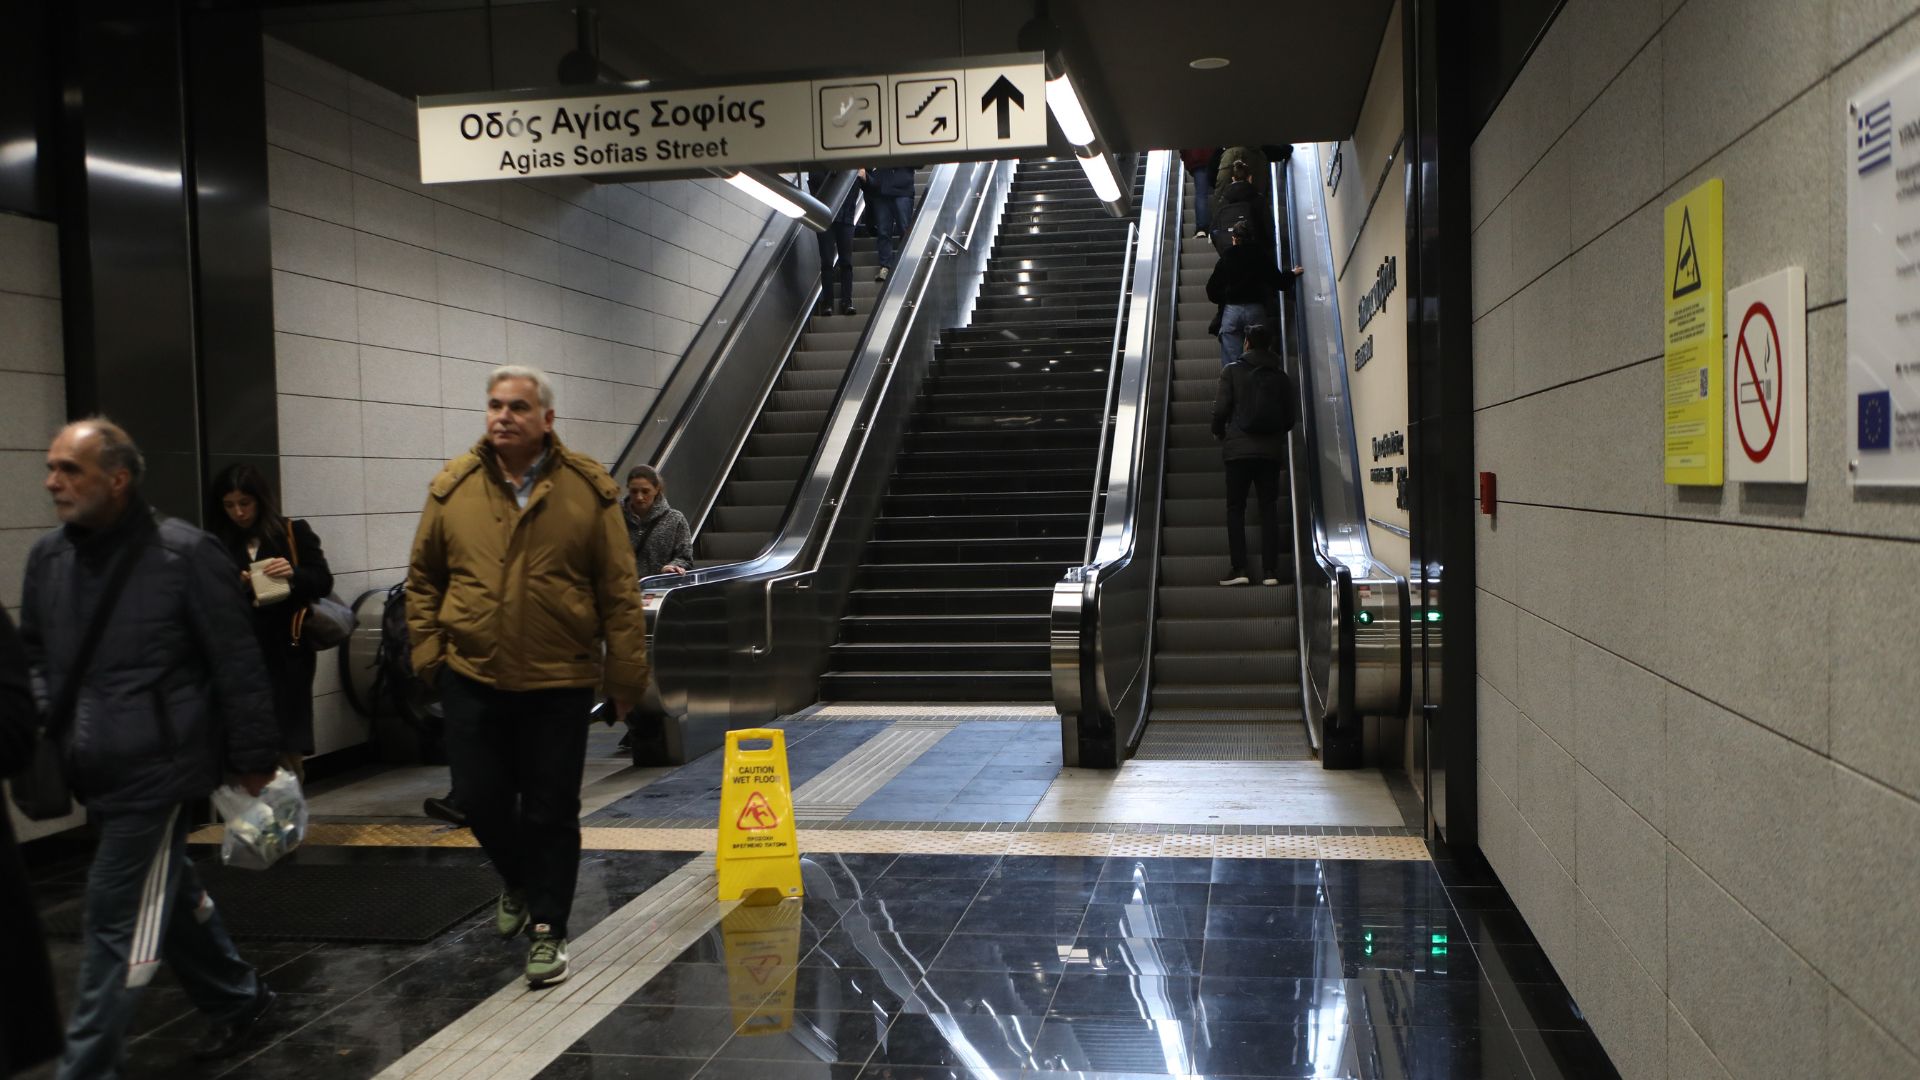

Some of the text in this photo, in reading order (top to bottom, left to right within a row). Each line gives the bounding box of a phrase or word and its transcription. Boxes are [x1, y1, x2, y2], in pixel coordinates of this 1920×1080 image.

[460, 95, 765, 143] Οδός Αγίας Σοφίας
[499, 137, 729, 174] Agias Sofias Street
[733, 776, 751, 784] WET
[738, 766, 775, 774] CAUTION
